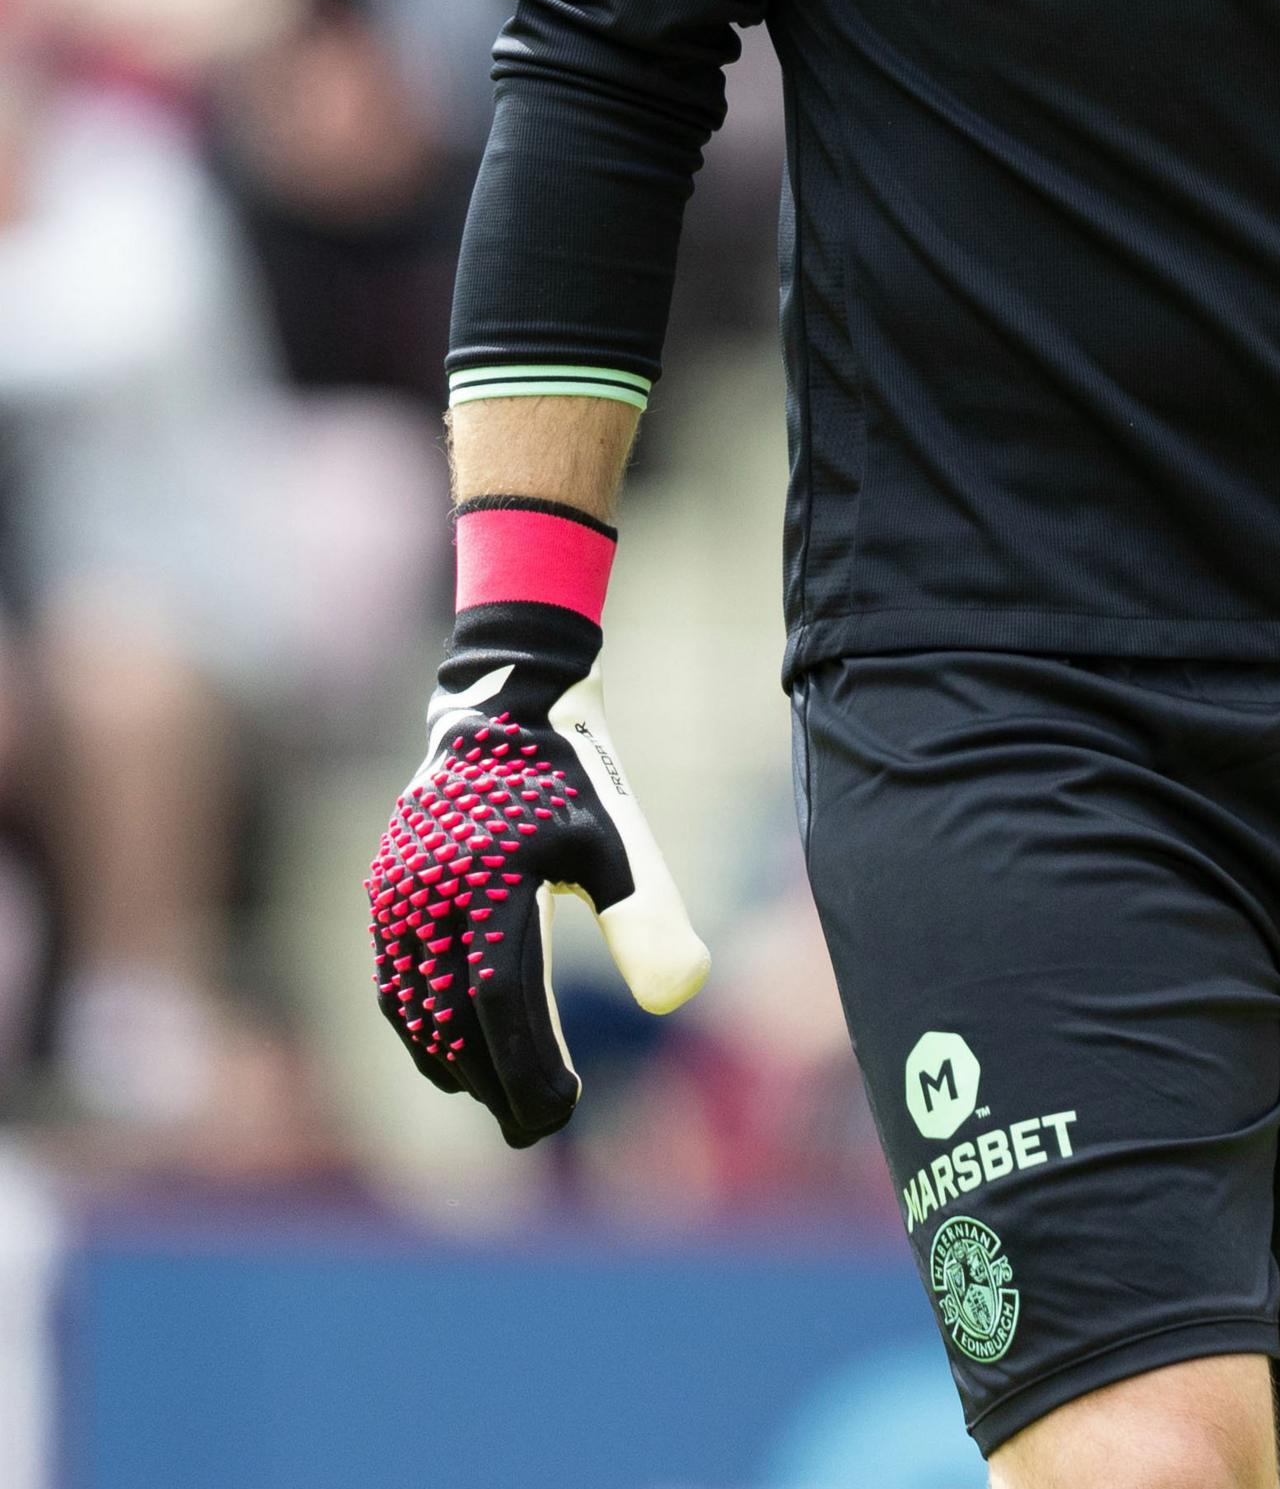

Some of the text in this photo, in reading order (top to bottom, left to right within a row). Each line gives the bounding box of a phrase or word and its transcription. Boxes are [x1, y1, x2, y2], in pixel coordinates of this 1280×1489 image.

[918, 1058, 959, 1113] M
[903, 1110, 1077, 1234] MARSBET
[934, 1223, 992, 1280] HIBERNIAN
[961, 1302, 1015, 1358] EDINBURGH
